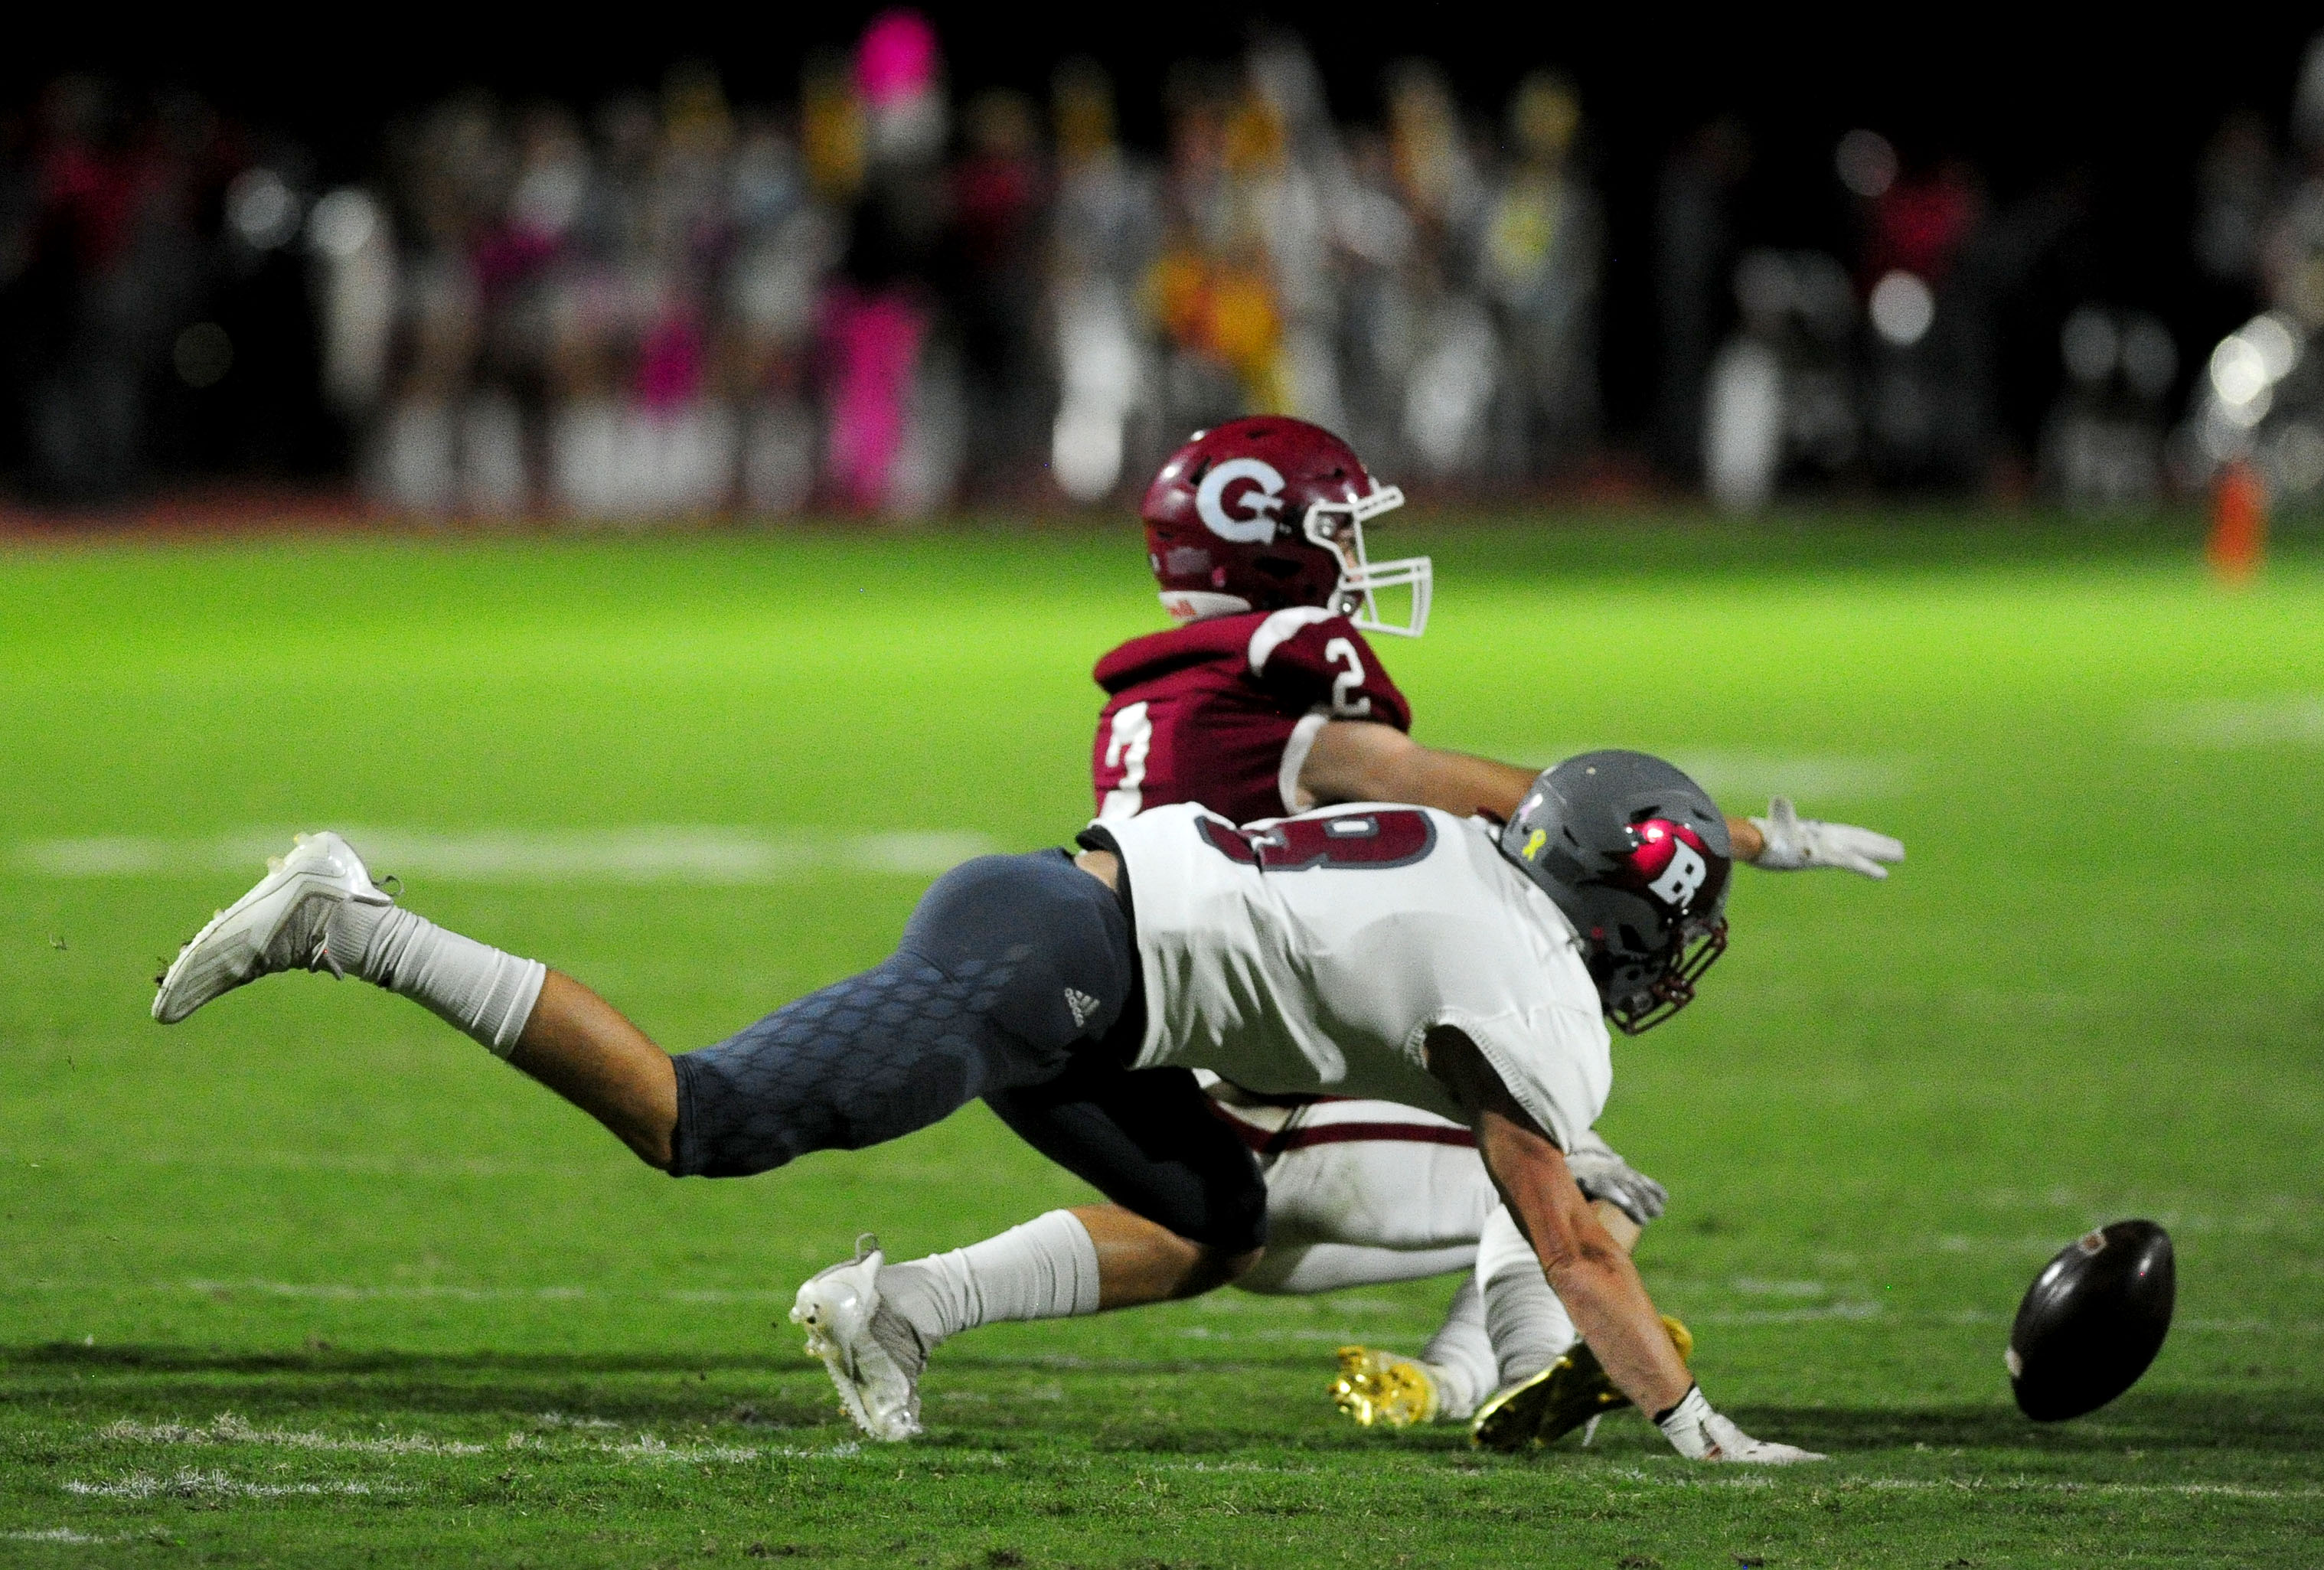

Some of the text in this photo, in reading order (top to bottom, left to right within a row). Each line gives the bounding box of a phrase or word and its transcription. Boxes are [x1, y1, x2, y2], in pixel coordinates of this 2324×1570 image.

[1196, 457, 1285, 545] G
[1325, 637, 1371, 716] 2
[1648, 835, 1707, 908] B
